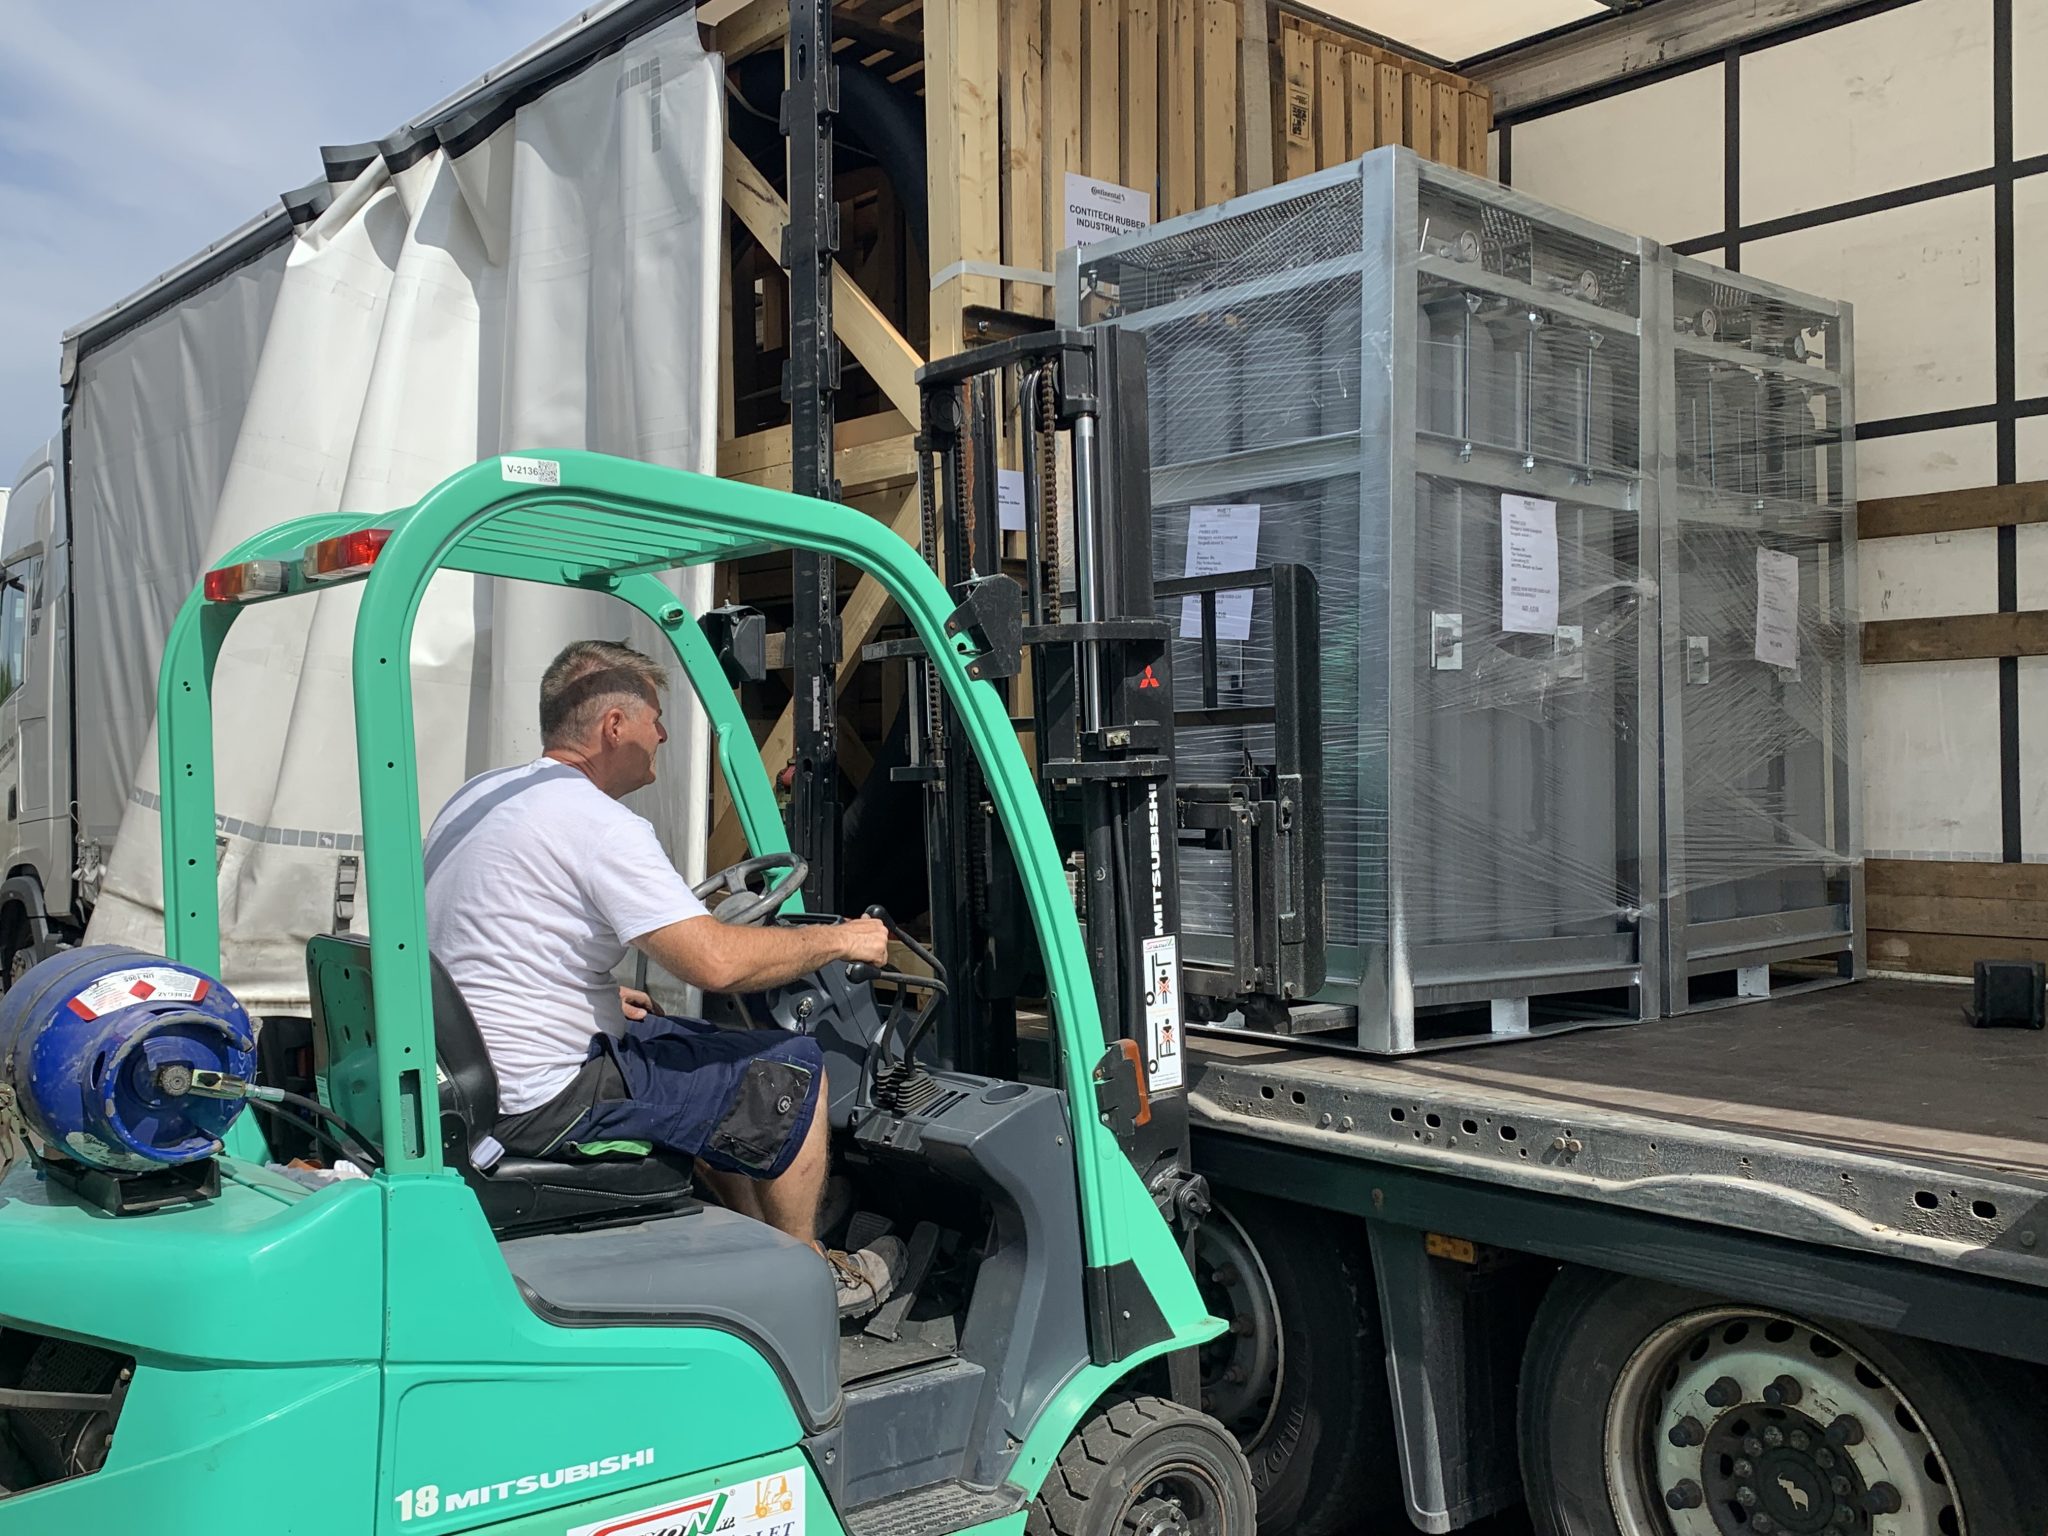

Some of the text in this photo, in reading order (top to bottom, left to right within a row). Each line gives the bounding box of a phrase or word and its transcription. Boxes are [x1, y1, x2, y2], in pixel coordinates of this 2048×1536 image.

[1069, 204, 1146, 229] CONTITECH RUBBER
[1076, 217, 1121, 236] INDUSTRIAL
[507, 464, 538, 475] V-2136
[1148, 783, 1164, 937] MITSUBISHI
[395, 1448, 655, 1522] 18 MITSUBISHI
